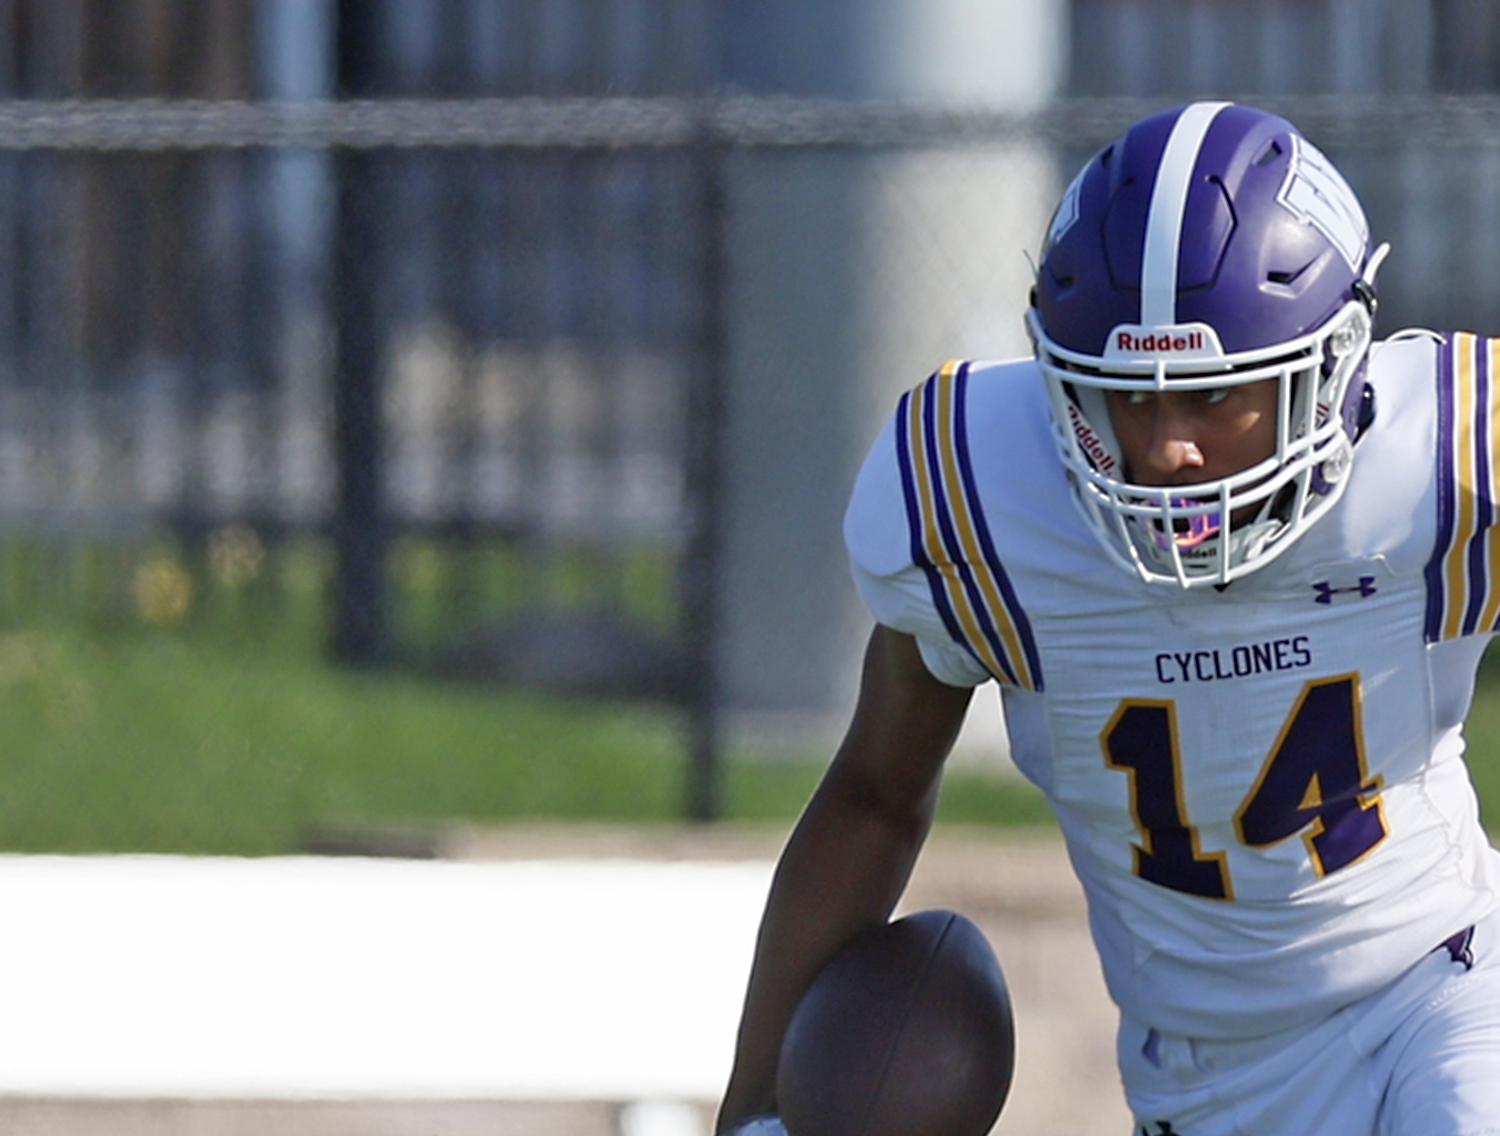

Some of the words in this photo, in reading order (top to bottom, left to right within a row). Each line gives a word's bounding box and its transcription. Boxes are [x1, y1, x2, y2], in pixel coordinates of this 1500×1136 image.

[1117, 332, 1202, 351] Riddell
[1182, 547, 1217, 559] iddell
[1155, 636, 1311, 683] CYCLONES
[1100, 671, 1390, 901] 14
